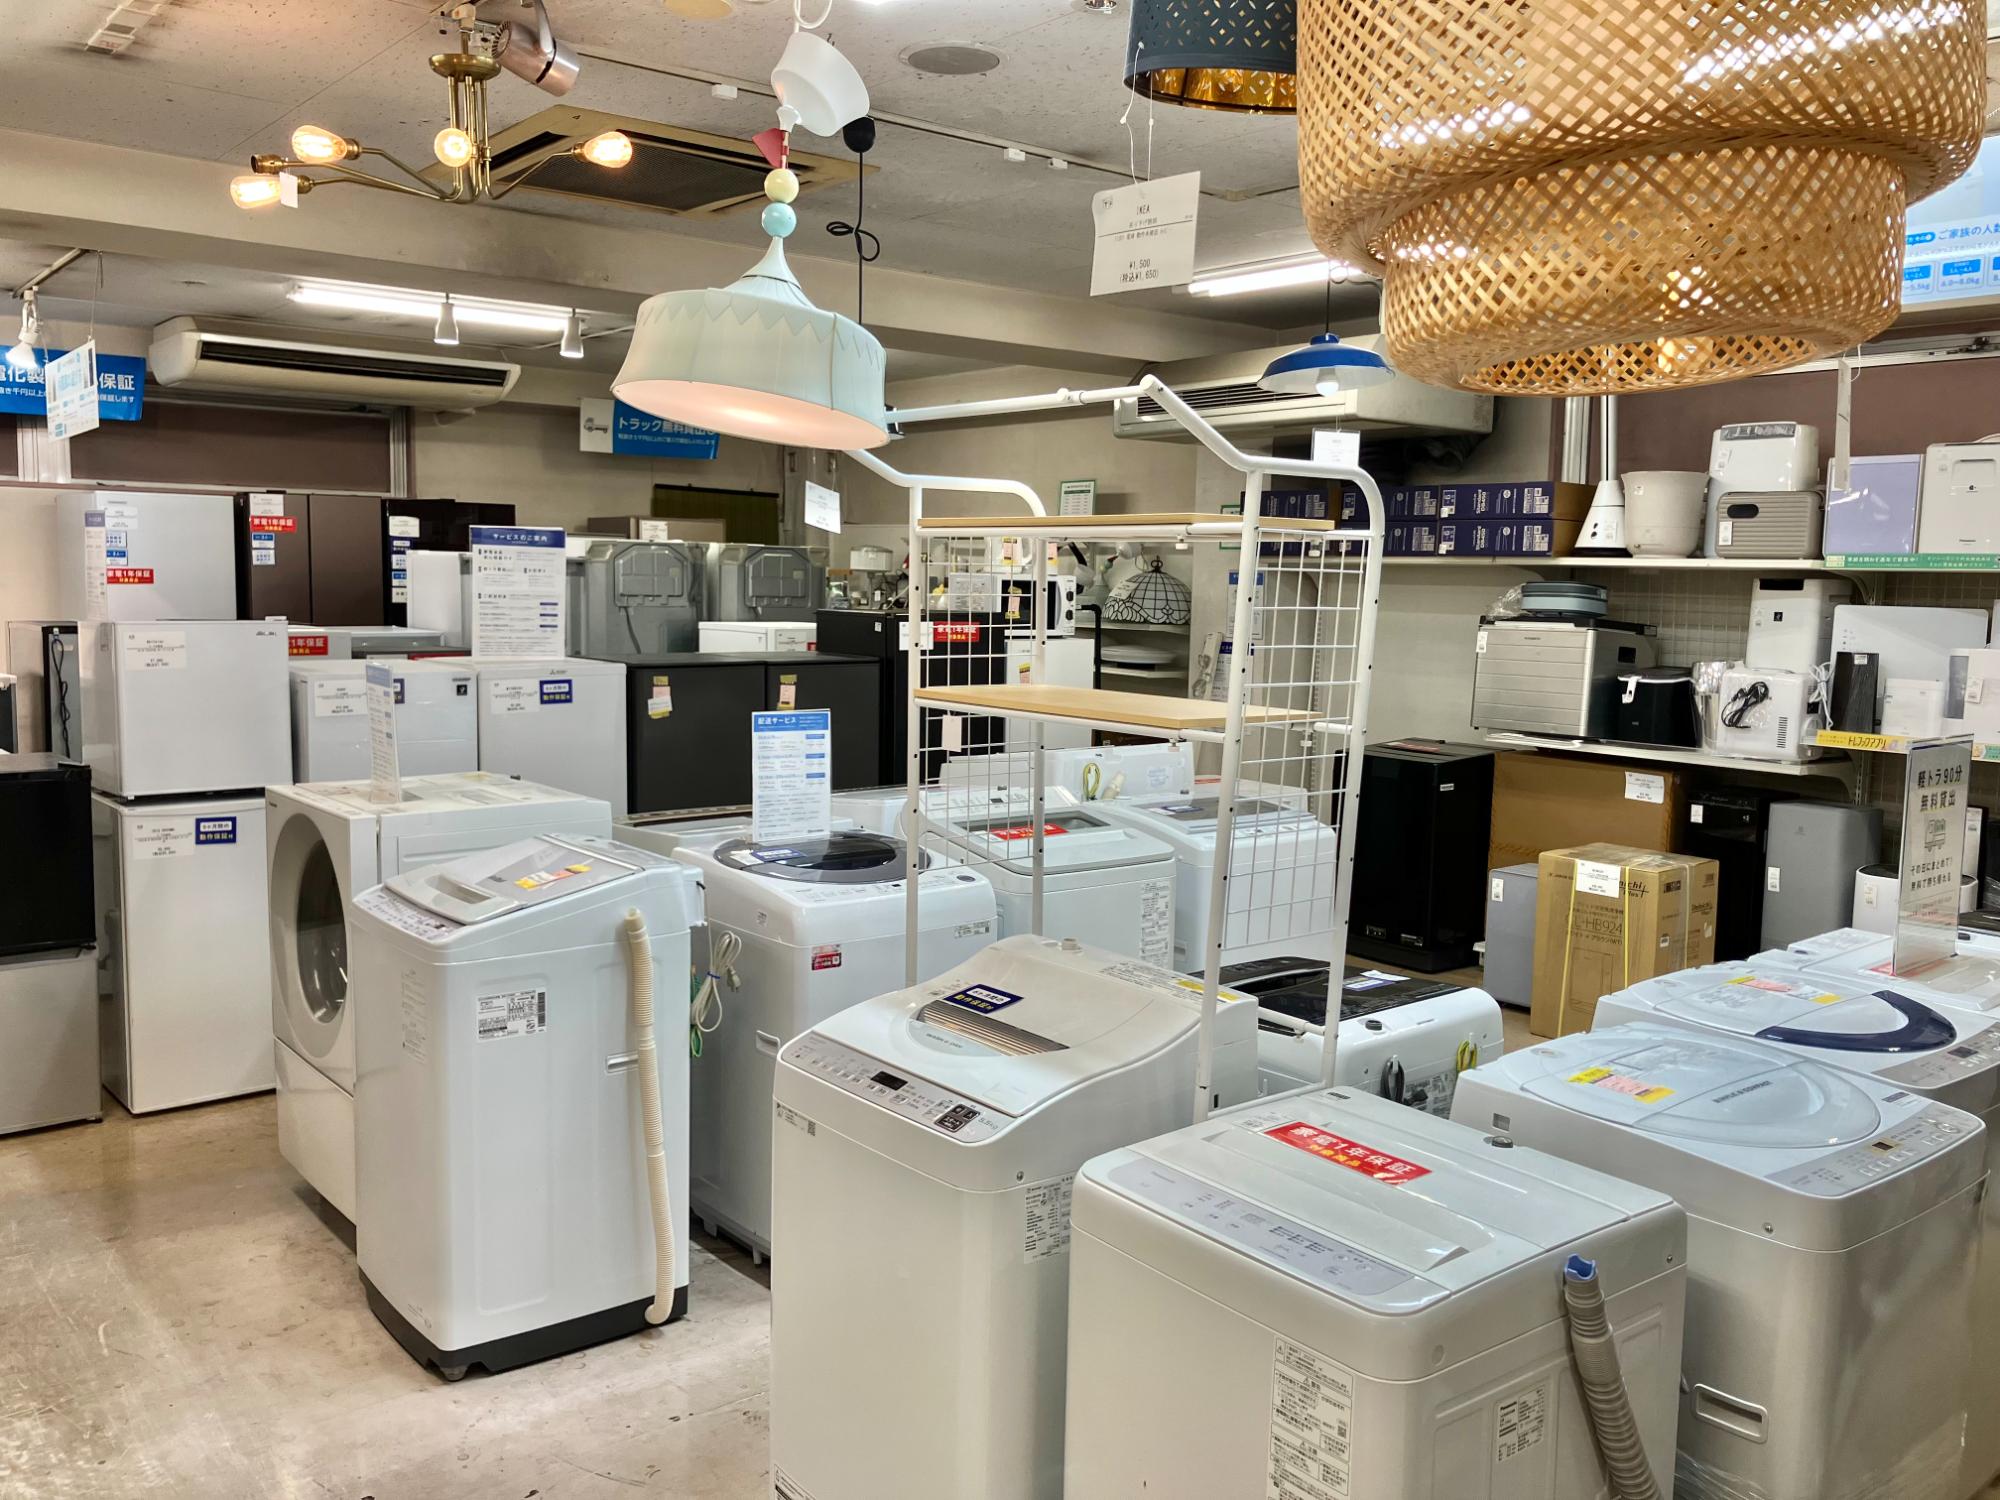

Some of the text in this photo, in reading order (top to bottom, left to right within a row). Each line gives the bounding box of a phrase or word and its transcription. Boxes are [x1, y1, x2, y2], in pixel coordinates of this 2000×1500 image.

[1129, 258, 1151, 268] ¥1,500
[98, 371, 136, 391] 保証
[288, 637, 325, 647] 1年保証
[1917, 764, 1963, 790] 軽トラ90分
[1920, 790, 1956, 812] 無料貸出
[1288, 1125, 1417, 1175] 家電1年保証
[1306, 1144, 1361, 1167] 対象商品
